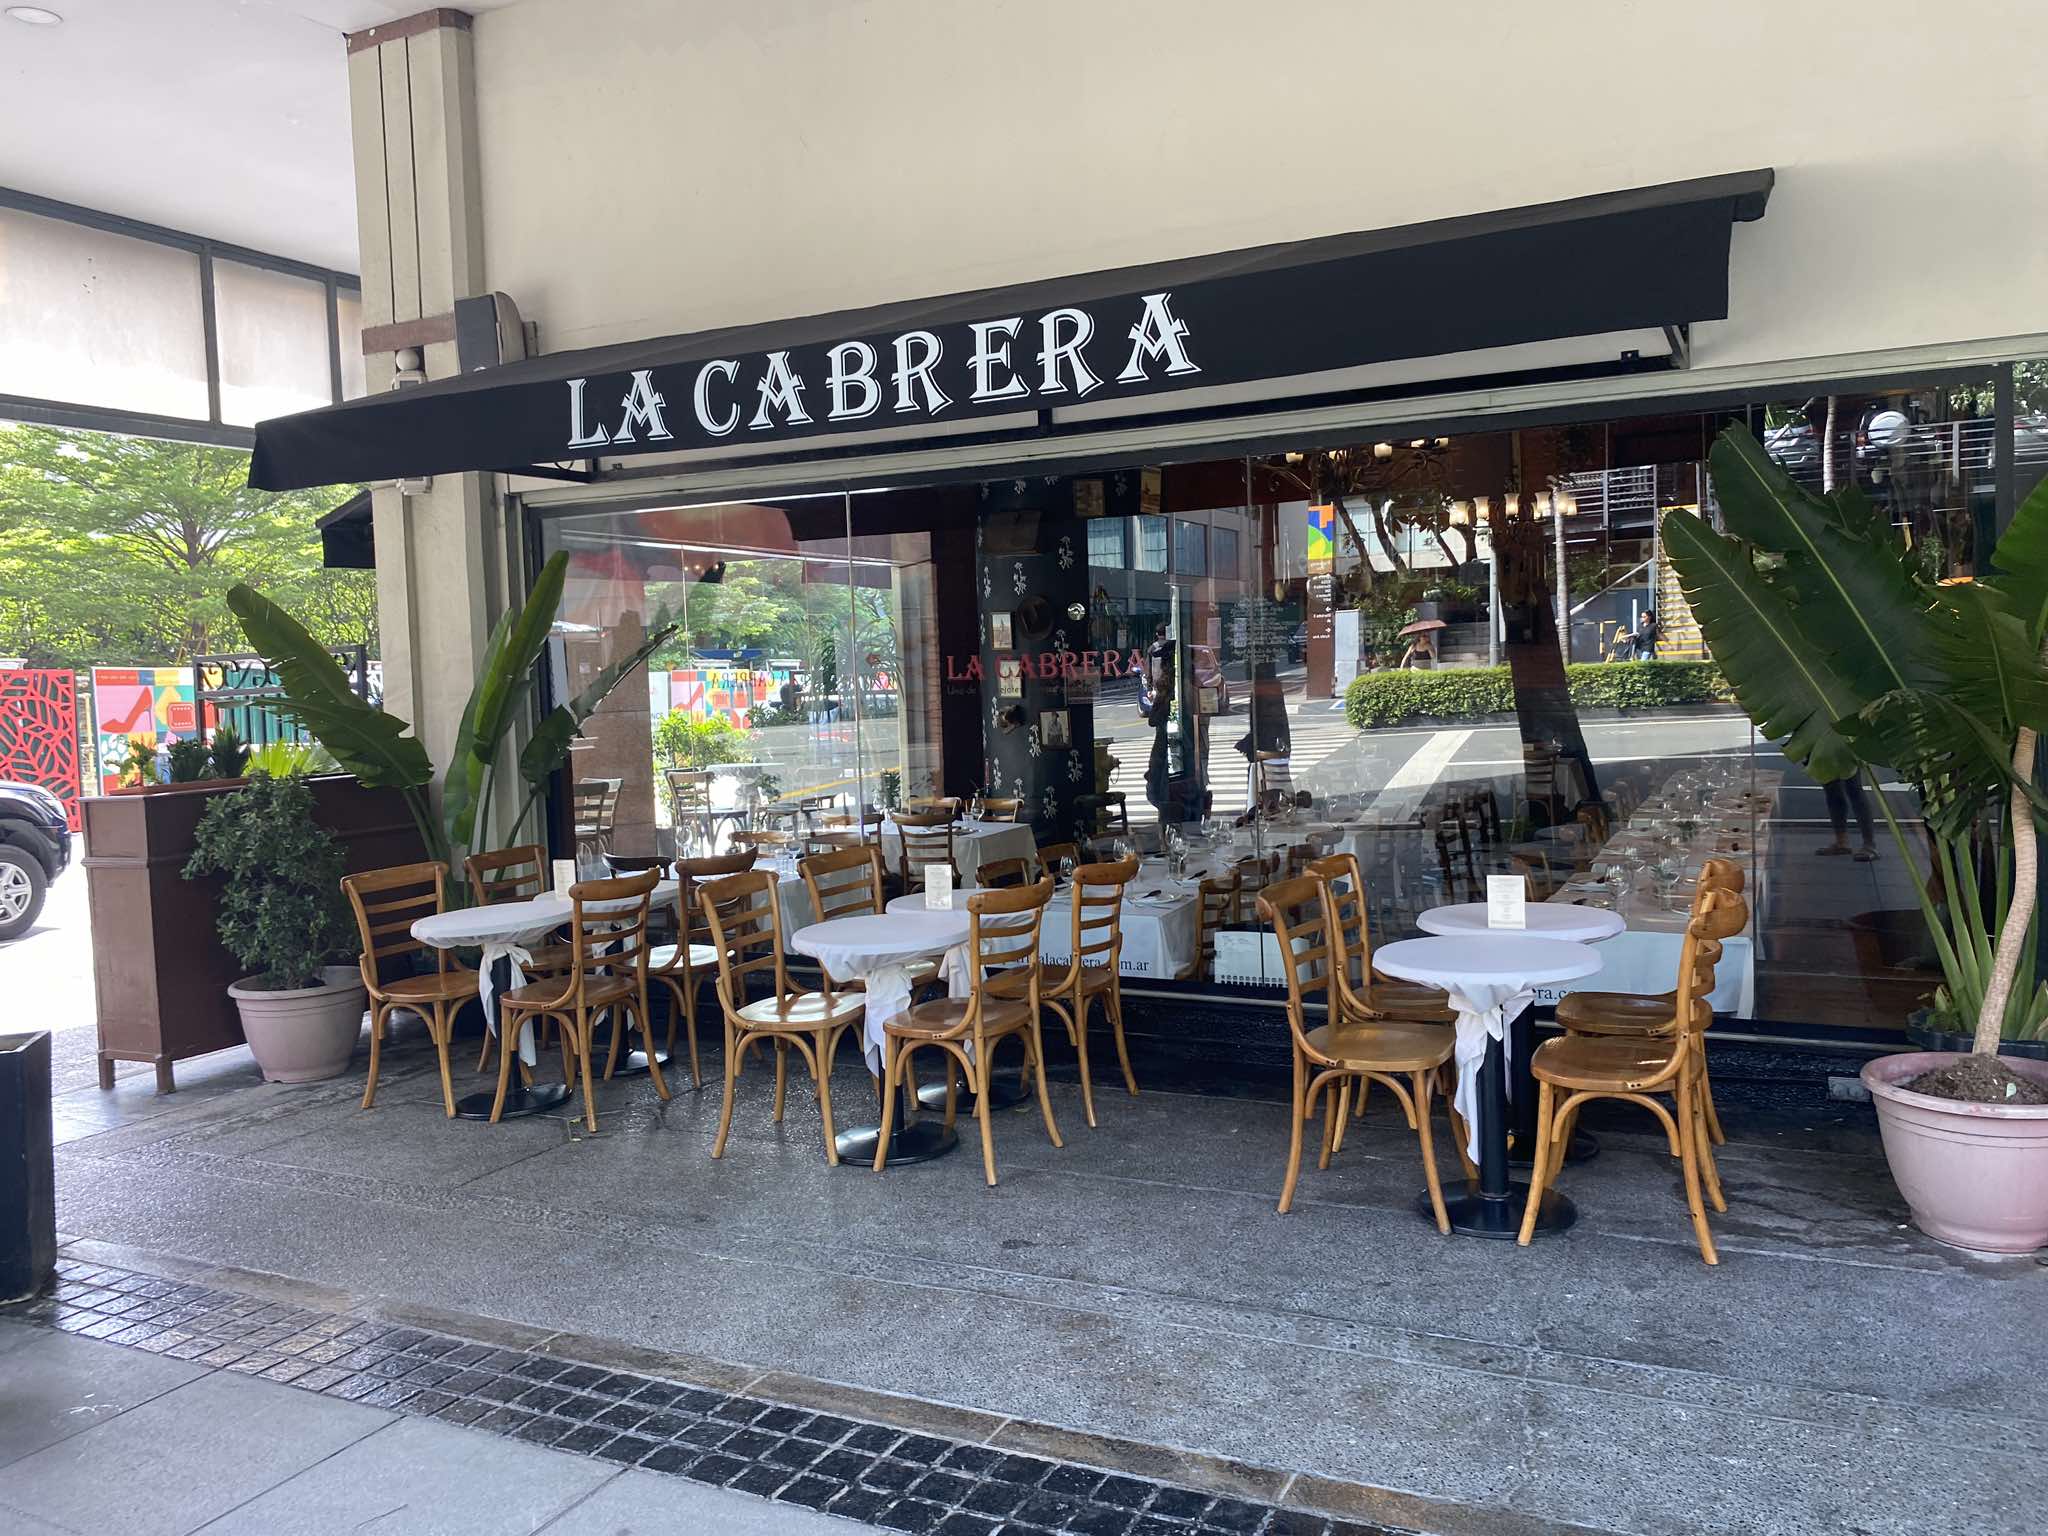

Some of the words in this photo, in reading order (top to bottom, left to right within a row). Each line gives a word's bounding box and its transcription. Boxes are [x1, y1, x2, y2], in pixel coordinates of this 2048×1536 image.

[567, 369, 675, 450] LA
[693, 292, 1203, 437] CABRERA
[946, 654, 984, 680] LA
[995, 648, 1146, 680] CABRERA
